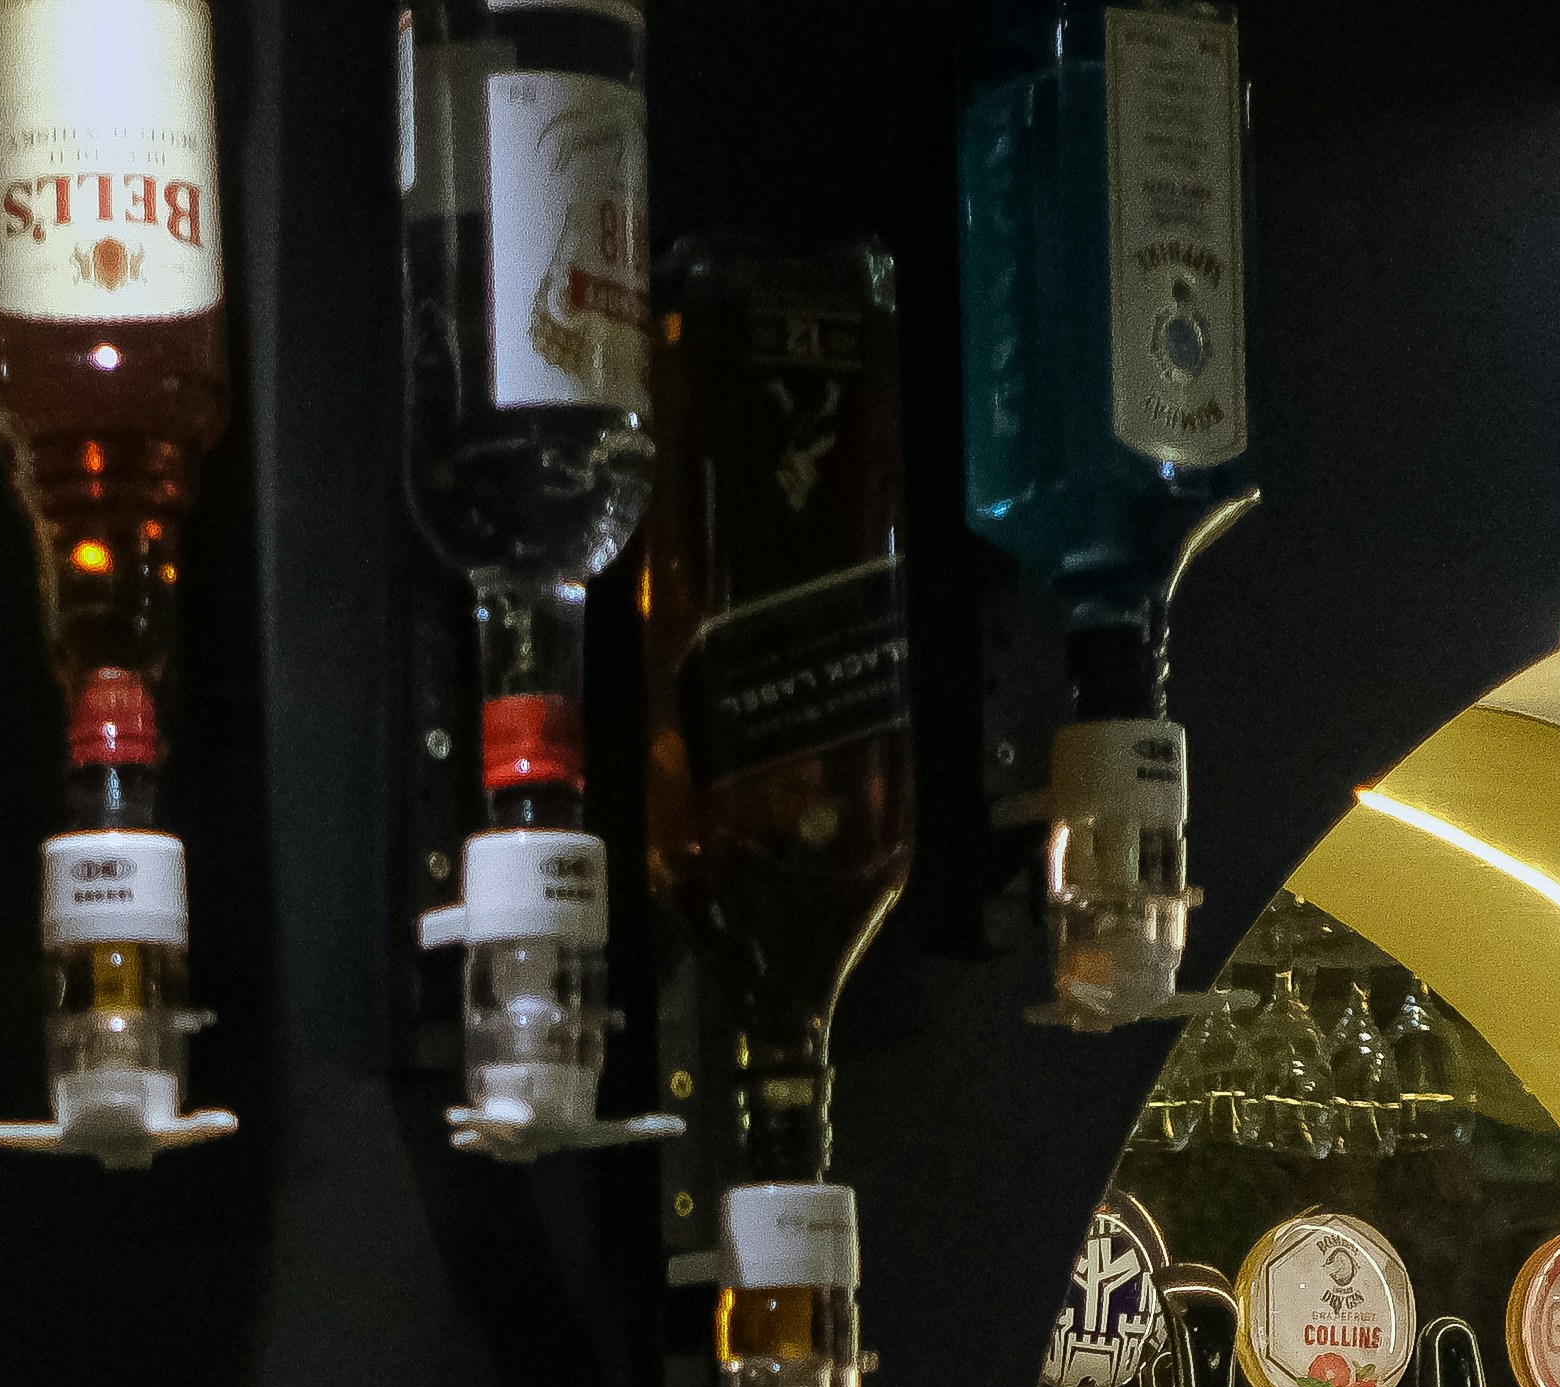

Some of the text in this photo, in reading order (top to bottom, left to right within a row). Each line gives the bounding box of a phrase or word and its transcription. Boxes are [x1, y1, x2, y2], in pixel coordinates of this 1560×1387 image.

[3, 173, 202, 251] BELL'S
[719, 668, 819, 714] LABEL
[1304, 1324, 1382, 1349] COLLINS
